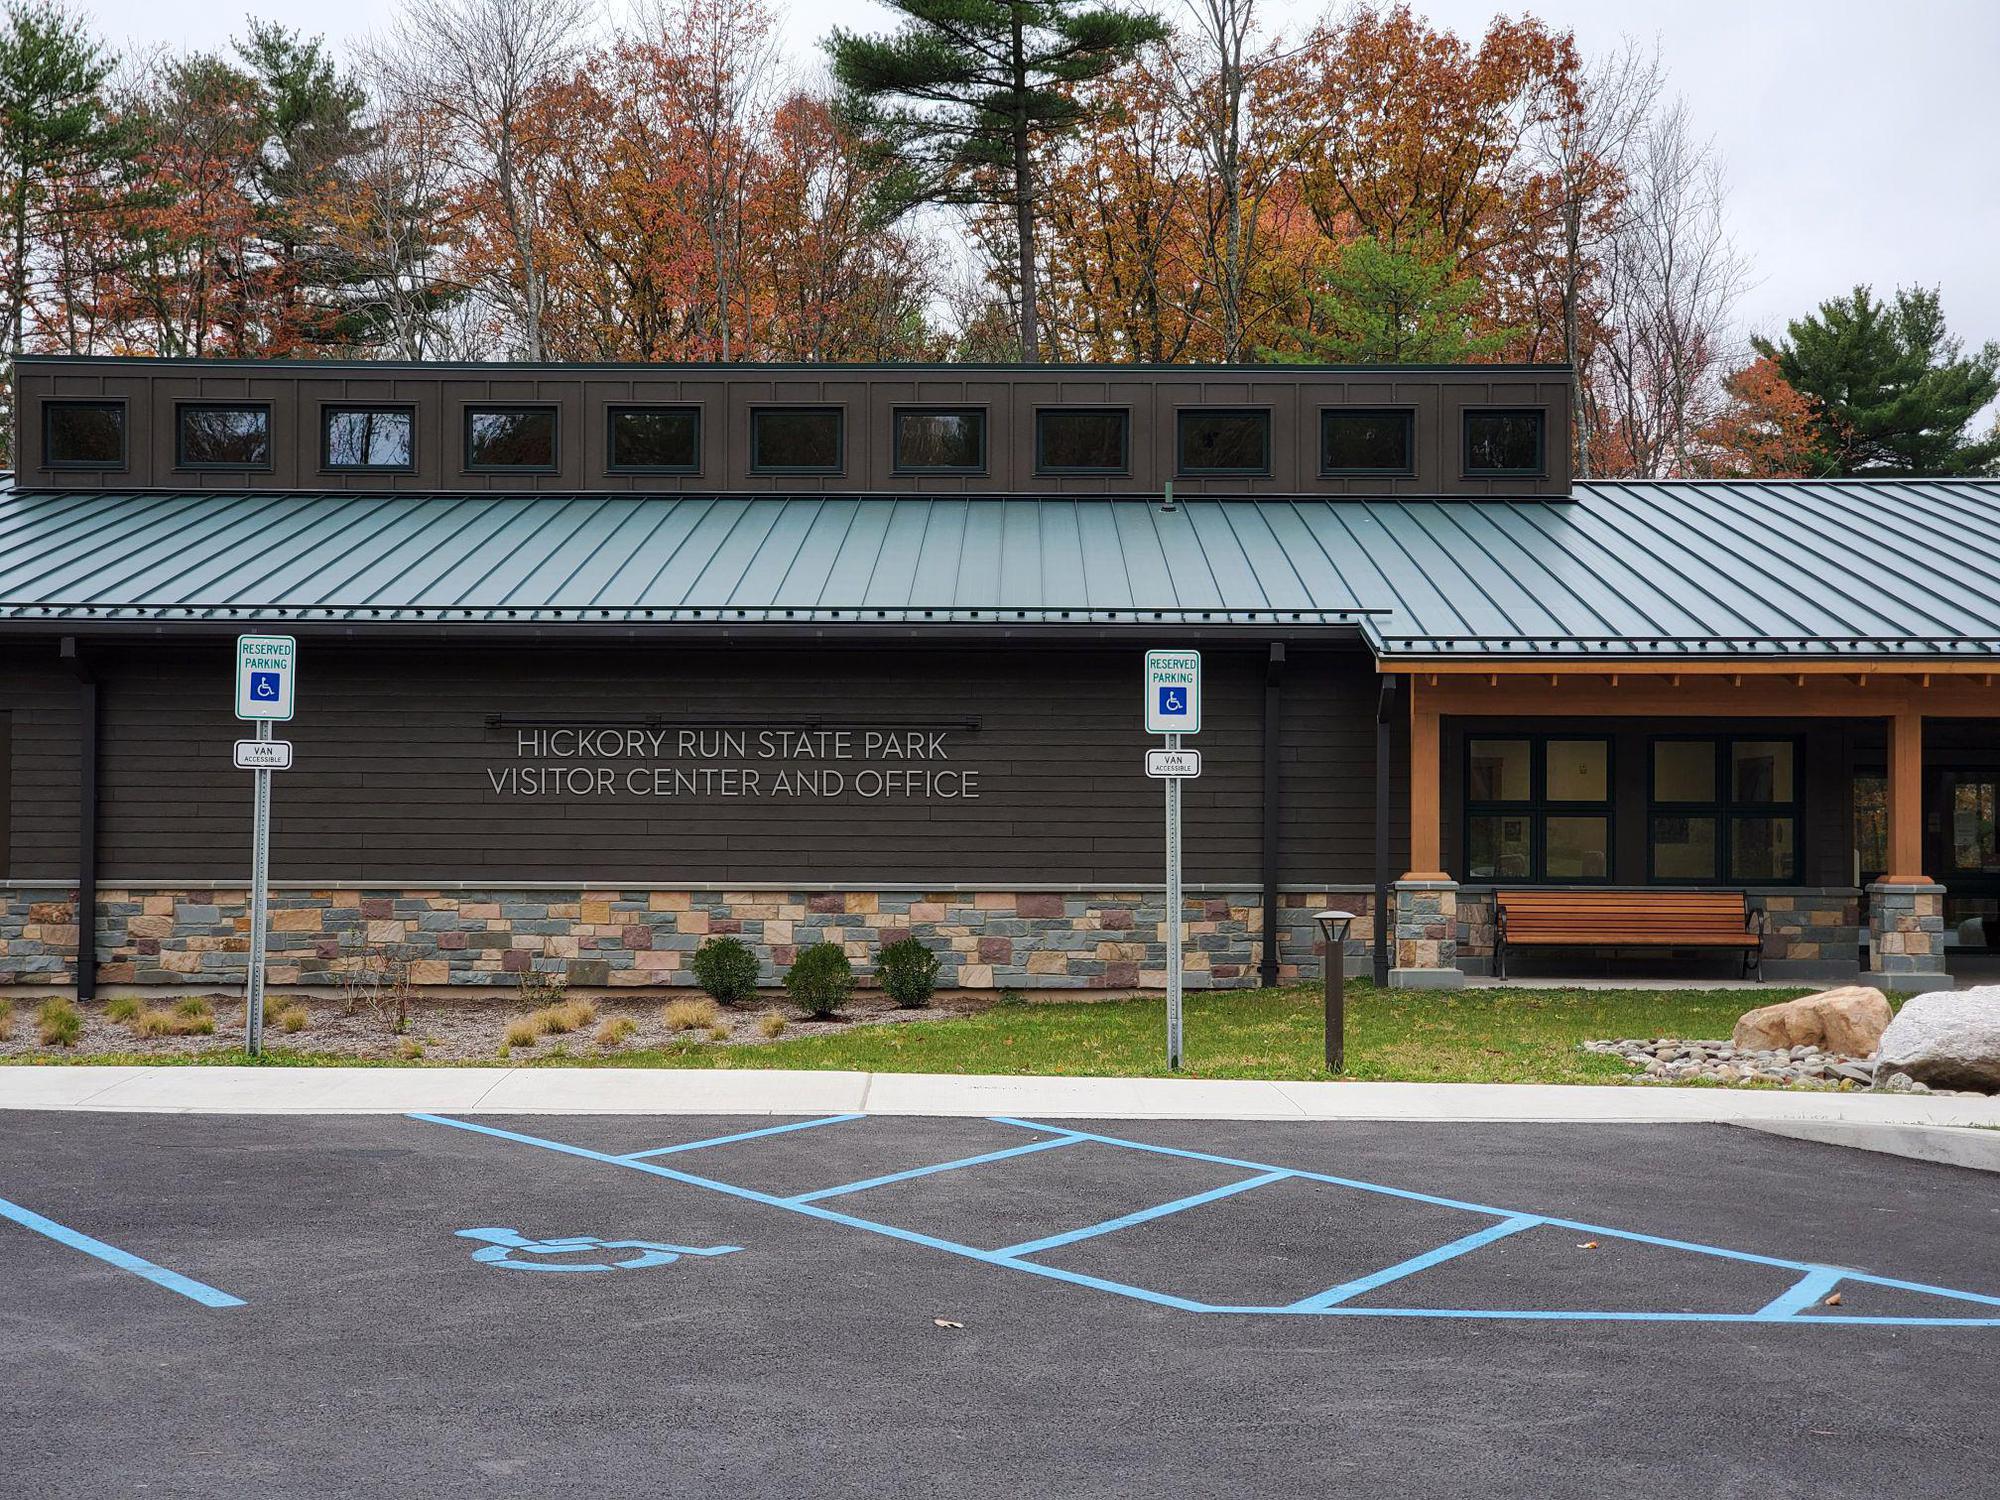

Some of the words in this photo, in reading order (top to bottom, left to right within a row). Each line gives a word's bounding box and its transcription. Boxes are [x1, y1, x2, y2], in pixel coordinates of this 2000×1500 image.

[242, 643, 291, 656] RESERVED
[245, 658, 288, 670] PARKING
[1150, 659, 1196, 670] RESERVED
[1153, 672, 1193, 683] PARKING
[517, 729, 666, 757] HICKORY
[678, 730, 746, 758] RUN
[757, 731, 853, 758] STATE
[865, 732, 948, 759] PARK
[254, 747, 273, 756] VAN
[1164, 756, 1182, 764] VAN
[486, 767, 617, 795] VISITOR
[626, 768, 760, 796] CENTER
[771, 769, 844, 797] AND
[855, 769, 980, 798] OFFICE
